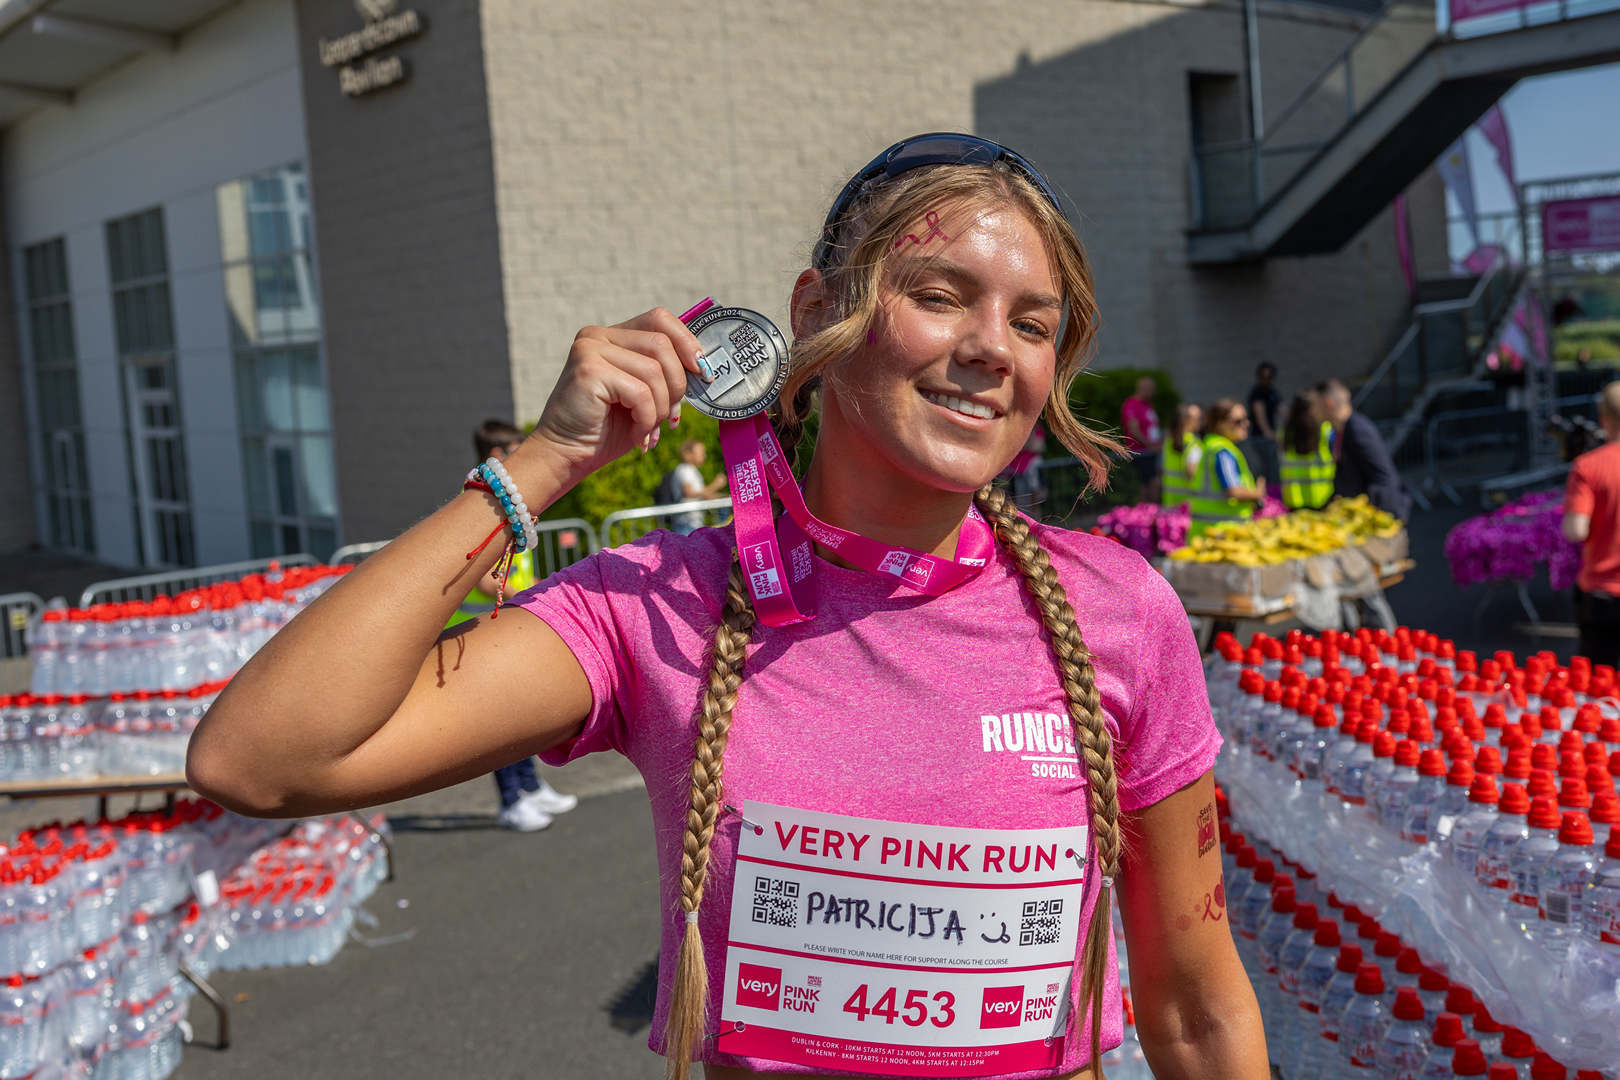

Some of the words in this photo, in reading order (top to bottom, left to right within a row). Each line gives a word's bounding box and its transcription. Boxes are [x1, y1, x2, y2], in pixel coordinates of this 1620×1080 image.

[690, 319, 704, 334] INK
[704, 312, 720, 324] RUN
[734, 338, 764, 364] PINK
[714, 360, 730, 380] ery
[740, 350, 769, 374] RUN
[715, 408, 744, 418] MADE
[754, 358, 788, 410] DIFFERENCE
[760, 438, 772, 459] PINK
[764, 436, 776, 456] RUN
[742, 462, 755, 500] CANCER
[771, 462, 784, 482] very
[735, 464, 748, 503] IRELAND
[754, 546, 765, 569] very
[791, 548, 800, 583] IRELAND
[796, 546, 807, 580] CANCER
[885, 558, 904, 567] PINK
[889, 552, 906, 561] RUN
[906, 564, 928, 577] very
[753, 575, 765, 595] RUN
[760, 572, 772, 595] PINK
[981, 713, 1080, 754] RUNCL
[1032, 763, 1076, 778] SOCIAL
[1200, 802, 1212, 818] SAVE
[774, 821, 870, 861] VERY
[881, 837, 971, 872] PINK
[983, 844, 1057, 873] RUN
[806, 892, 966, 945] PATRICIJA
[804, 943, 826, 952] PLEASE
[741, 978, 778, 997] very
[784, 985, 820, 1002] PINK
[783, 998, 815, 1013] RUN
[843, 984, 955, 1028] 4453
[985, 1000, 1020, 1015] very
[1026, 996, 1057, 1010] PINK
[1024, 1008, 1052, 1022] RUN
[792, 1036, 814, 1046] DUBLIN
[863, 1046, 886, 1054] STARTS
[806, 1048, 836, 1057] KILKENNY
